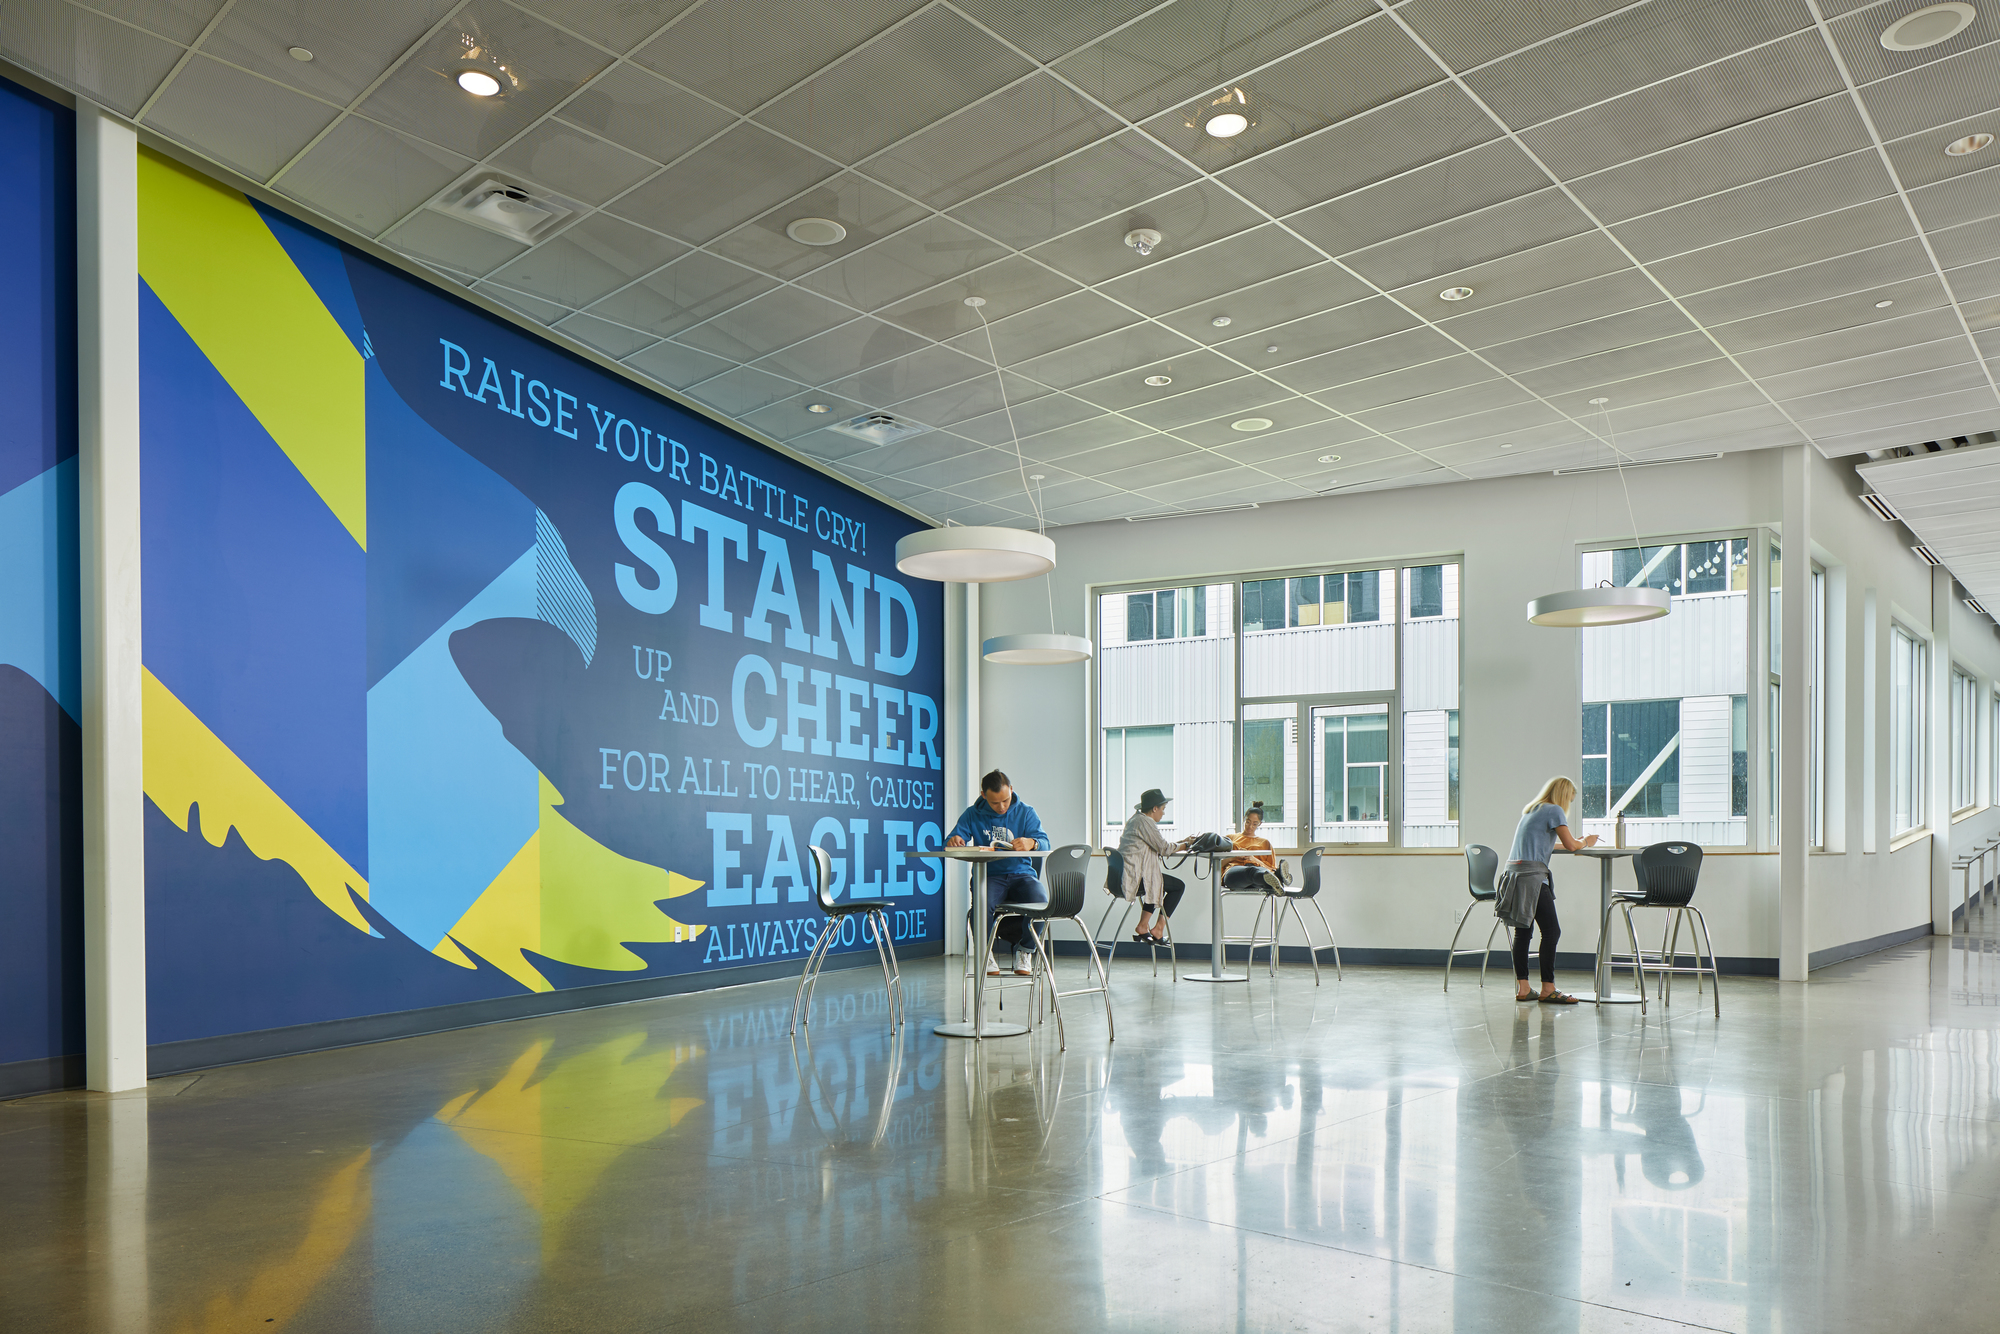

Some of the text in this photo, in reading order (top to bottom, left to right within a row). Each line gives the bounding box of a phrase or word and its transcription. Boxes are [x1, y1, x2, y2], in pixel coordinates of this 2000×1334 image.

[440, 338, 867, 556] RAISE YOUR BATTLE CRY!
[614, 482, 919, 676] STAND
[633, 645, 673, 682] UP
[659, 654, 941, 771] AND CHEER
[599, 748, 671, 794] FOR
[678, 756, 738, 797] ALL
[744, 762, 781, 801] TO
[788, 767, 860, 809] HEAR,
[706, 811, 943, 907] EAGLES
[703, 918, 819, 963] ALWAYS
[823, 914, 856, 949] DO
[895, 909, 927, 941] DIE
